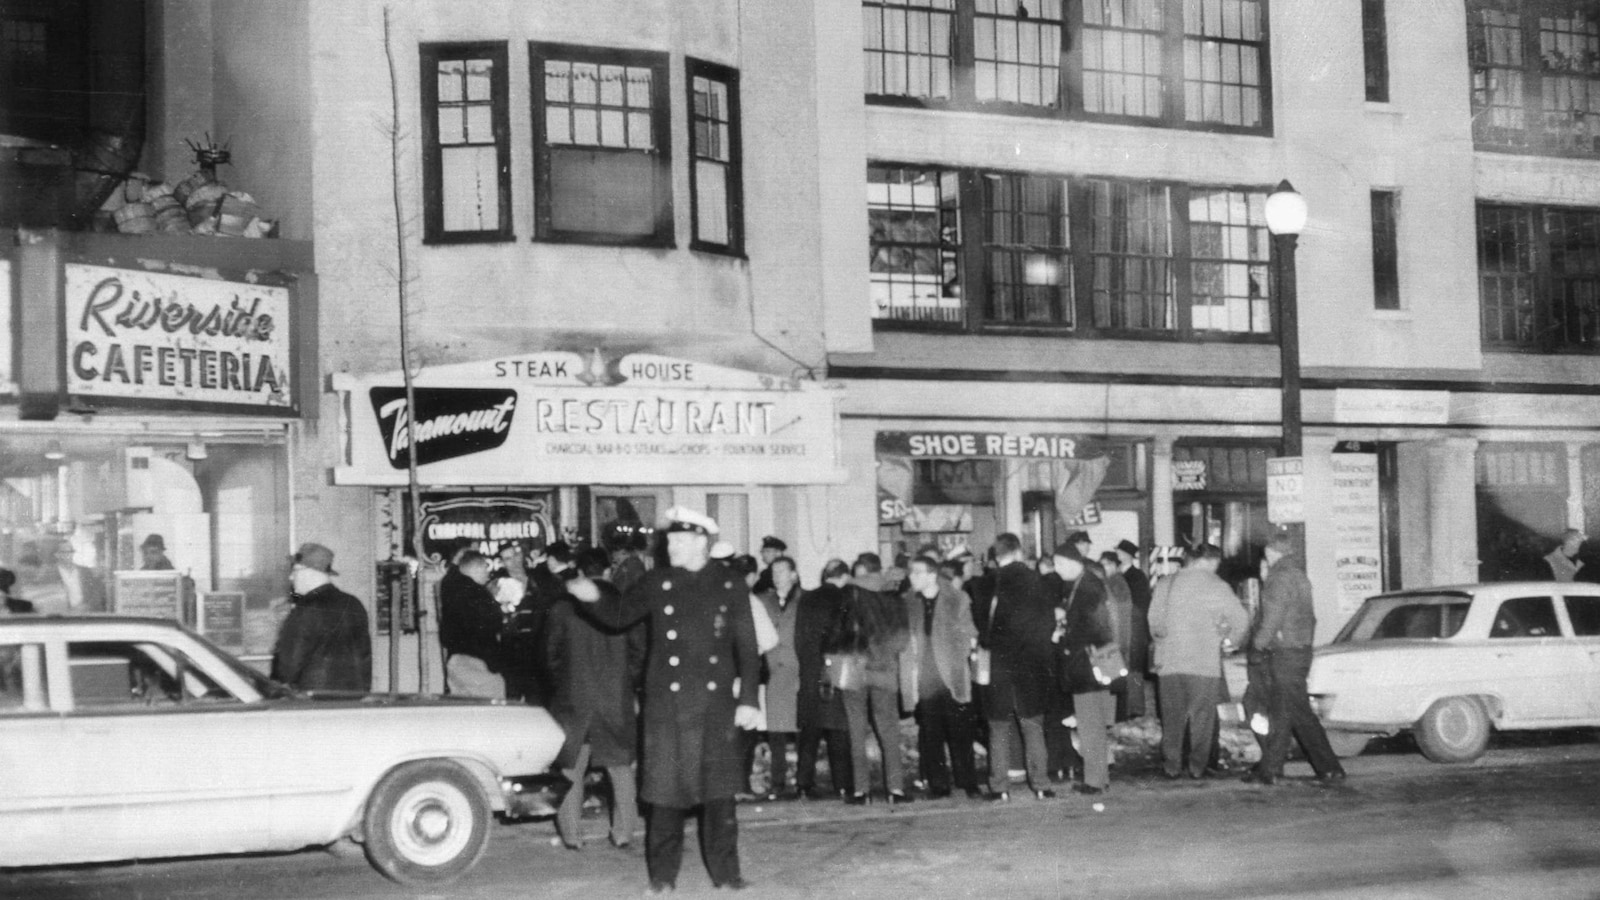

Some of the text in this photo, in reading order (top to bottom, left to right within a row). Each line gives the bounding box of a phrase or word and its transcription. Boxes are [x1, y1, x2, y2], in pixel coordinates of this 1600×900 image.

[80, 277, 274, 341] Riverside
[72, 340, 281, 393] CAFETERIA
[495, 361, 693, 381] STEAK HOUSE
[536, 399, 775, 436] RESTAURANT
[909, 434, 1076, 458] SHOE REPAIR
